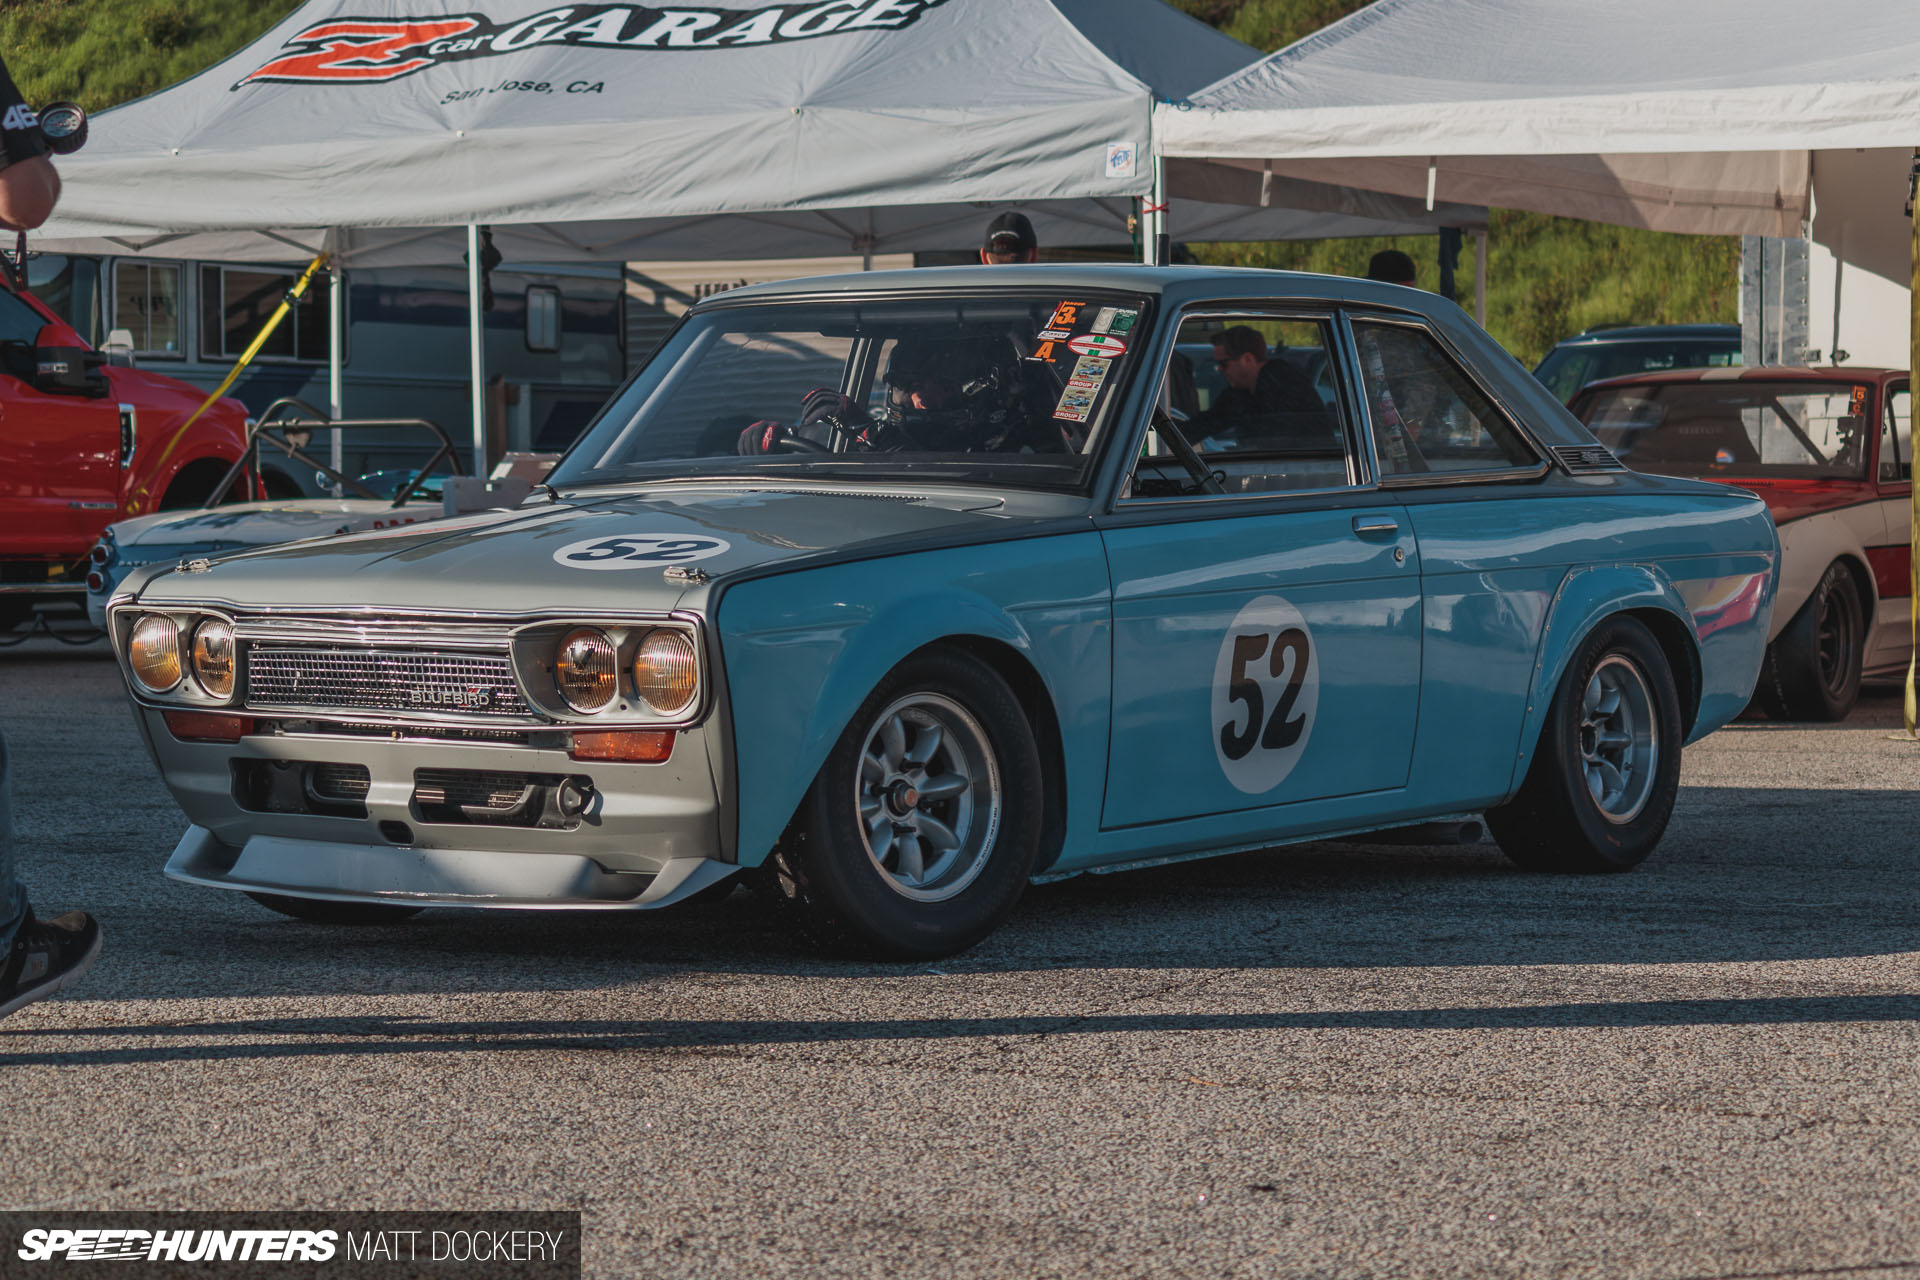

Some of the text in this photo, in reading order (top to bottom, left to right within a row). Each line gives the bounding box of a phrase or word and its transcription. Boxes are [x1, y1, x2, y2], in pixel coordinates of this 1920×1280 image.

[429, 34, 494, 55] car
[490, 0, 920, 52] GARAGE
[440, 79, 605, 105] San Jose, CA
[2, 104, 39, 131] 46
[1034, 341, 1054, 359] A
[1055, 411, 1078, 419] GROUP
[566, 538, 720, 561] 52
[410, 690, 490, 706] BLUEBIRD
[1220, 627, 1310, 761] 52
